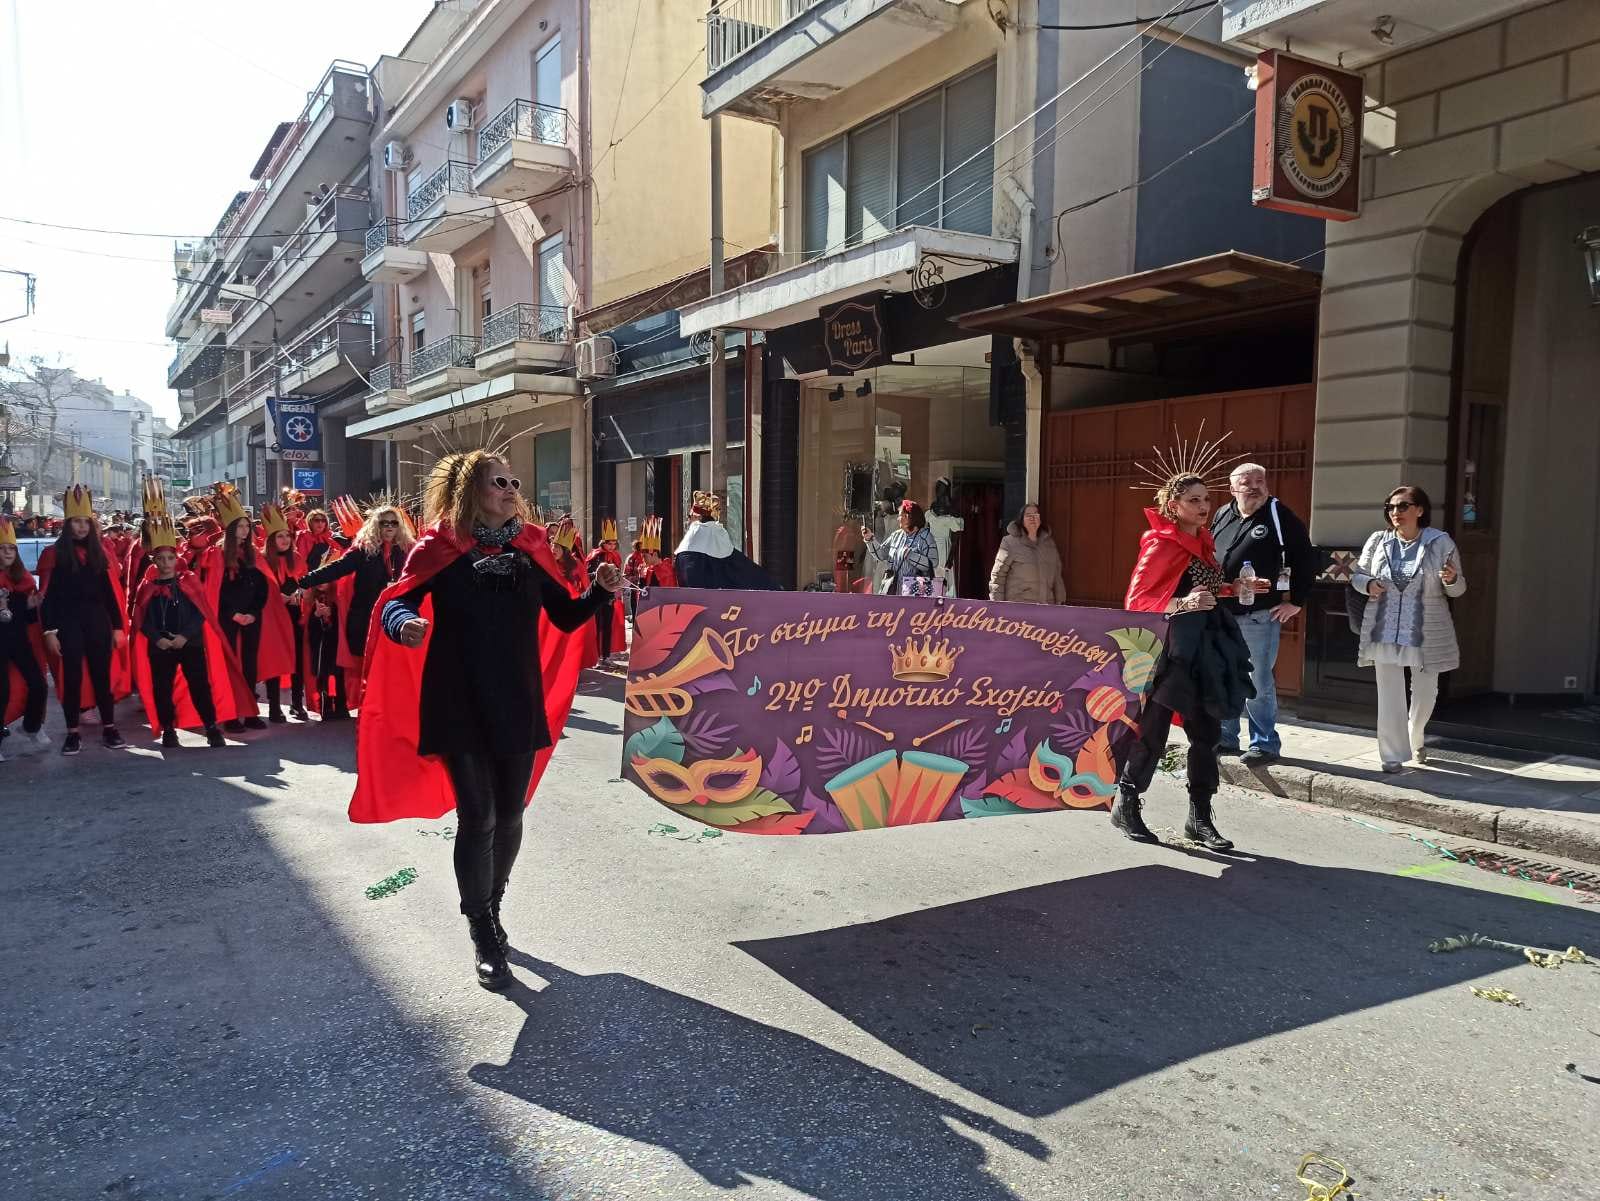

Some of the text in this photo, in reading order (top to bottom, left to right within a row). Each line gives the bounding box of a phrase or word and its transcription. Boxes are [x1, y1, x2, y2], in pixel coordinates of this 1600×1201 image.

[832, 320, 861, 340] Dress
[724, 627, 765, 657] Το
[770, 612, 860, 645] στέμμα
[867, 608, 905, 637] της
[828, 673, 964, 718] Δημοτικό
[966, 676, 1064, 716] Σχολείο
